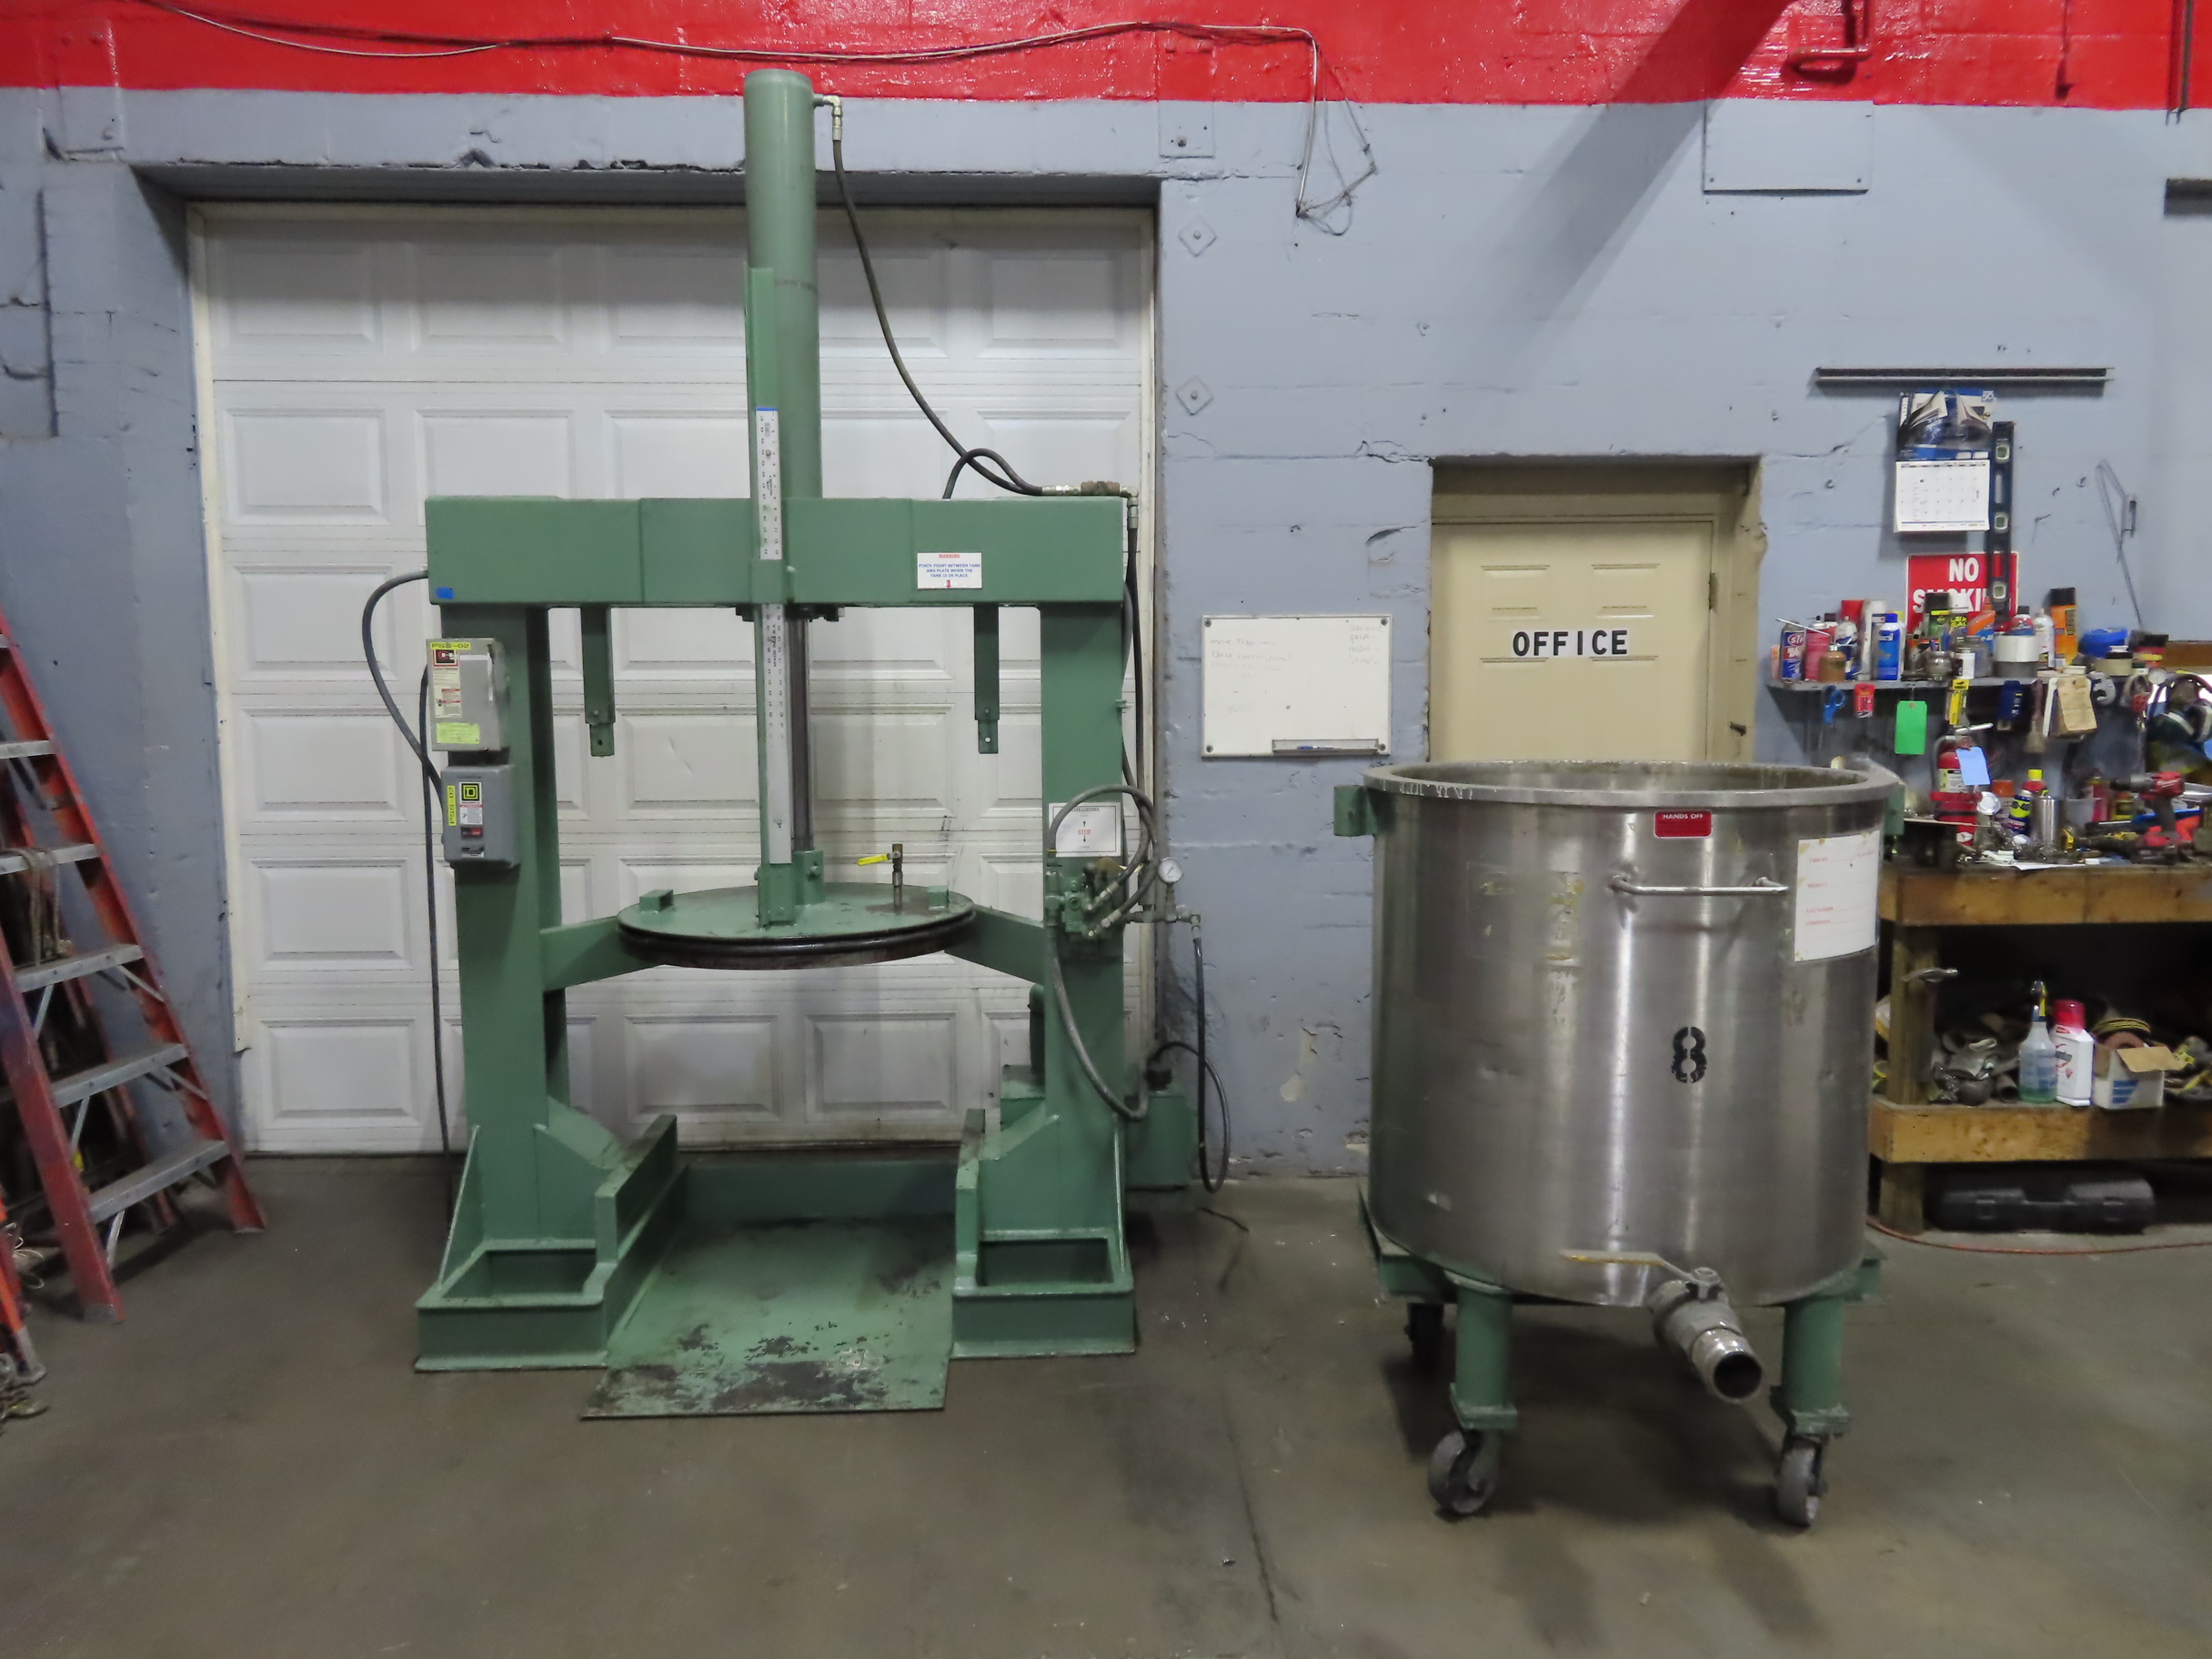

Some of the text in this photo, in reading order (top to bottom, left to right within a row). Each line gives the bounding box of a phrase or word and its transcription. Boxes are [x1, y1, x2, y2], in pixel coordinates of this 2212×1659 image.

[1949, 557, 1980, 582] NO
[1513, 629, 1628, 657] OFFICE
[1672, 1026, 1707, 1083] 8
